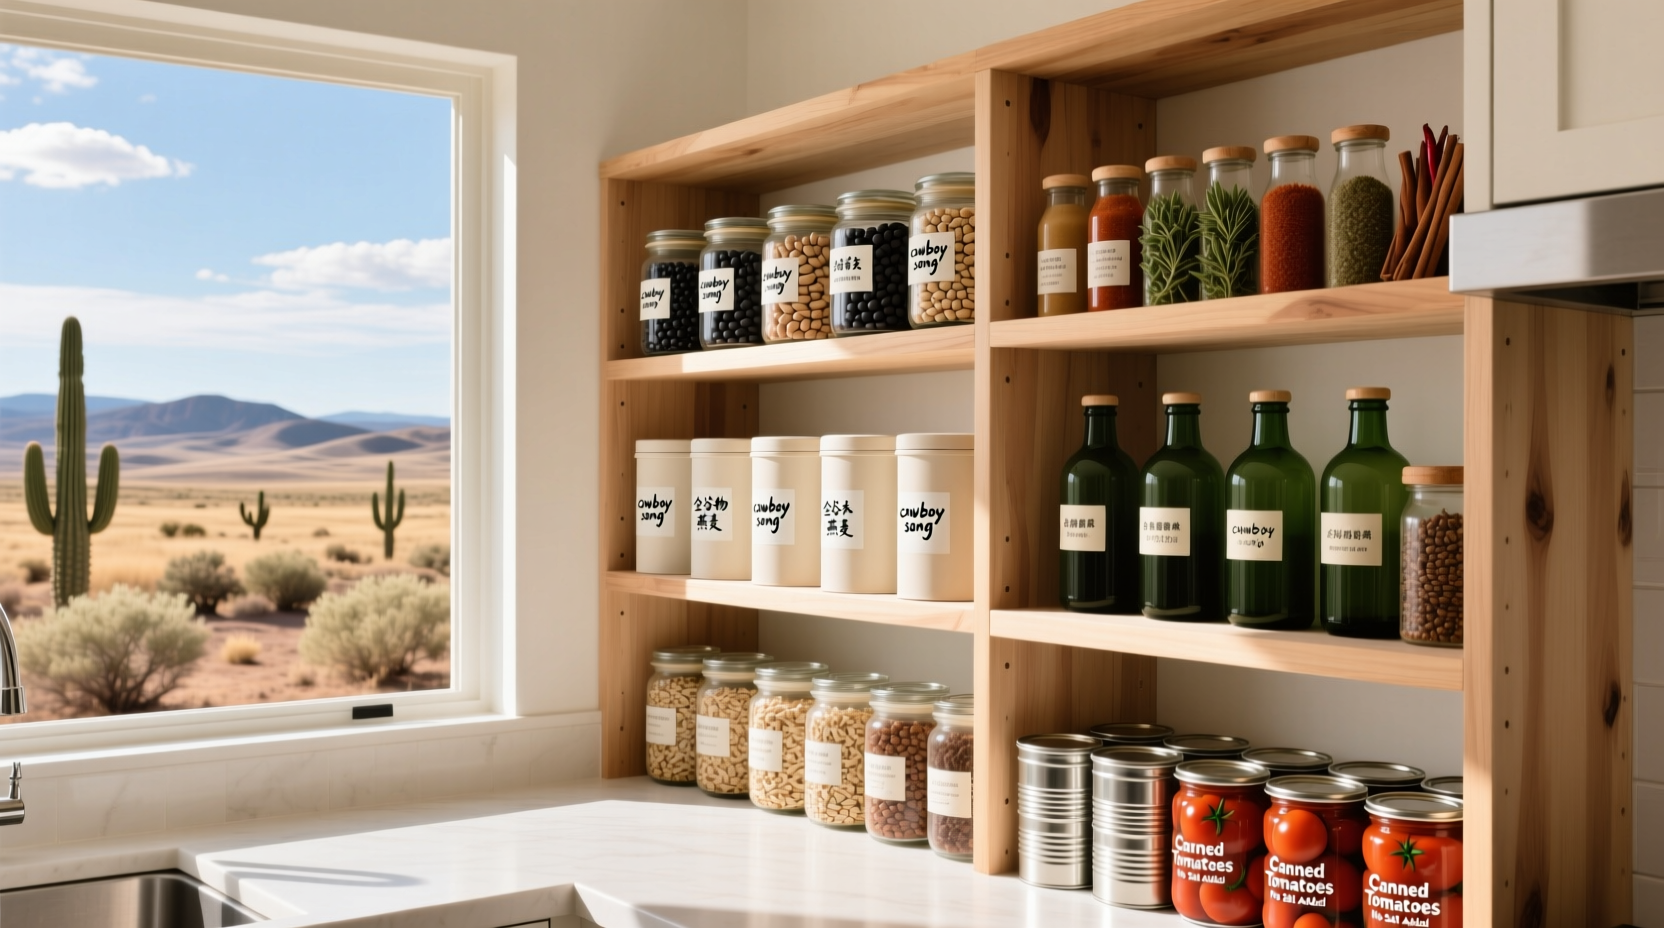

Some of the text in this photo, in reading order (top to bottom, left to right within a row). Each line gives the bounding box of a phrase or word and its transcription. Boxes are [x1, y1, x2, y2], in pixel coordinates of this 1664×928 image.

[913, 258, 939, 276] song
[641, 511, 665, 528] song
[756, 516, 781, 534] song
[904, 521, 934, 541] song
[1269, 855, 1325, 879] Canned
[1264, 870, 1335, 896] Tomatoes
[1368, 873, 1429, 898] Canned
[1364, 888, 1442, 916] Tomatoes
